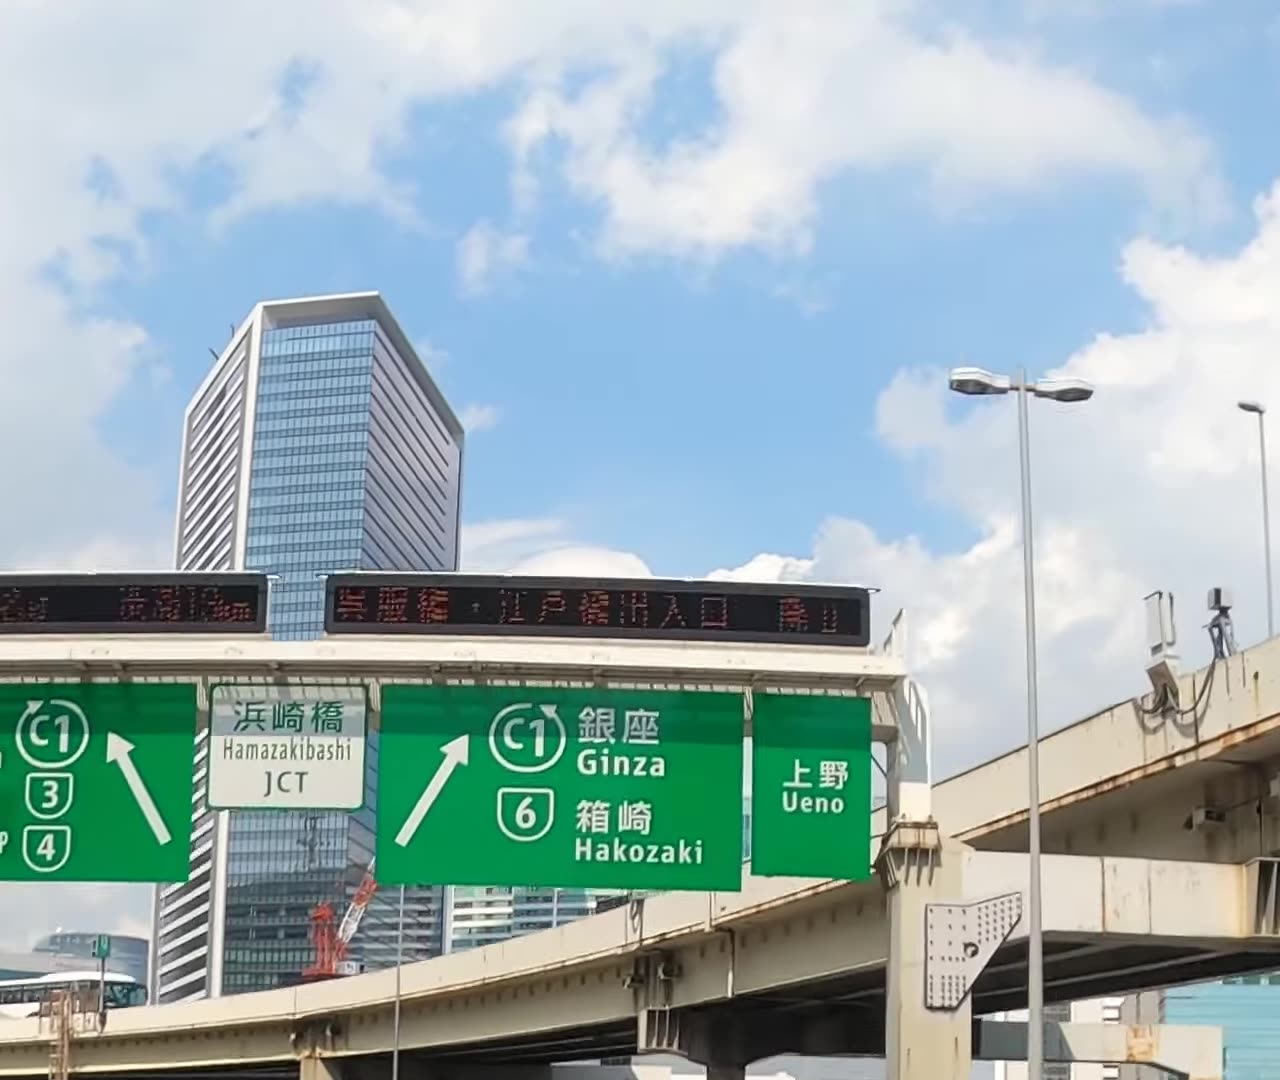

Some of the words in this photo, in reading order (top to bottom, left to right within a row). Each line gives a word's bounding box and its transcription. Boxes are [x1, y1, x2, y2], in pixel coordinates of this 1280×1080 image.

[234, 701, 343, 733] 浜崎橋
[579, 707, 659, 744] 銀座
[30, 716, 68, 752] C1
[224, 736, 350, 760] Hamazakibashi
[503, 718, 545, 758] C1
[578, 749, 664, 776] Ginza
[784, 760, 848, 789] 上野
[42, 780, 58, 808] 3
[264, 771, 309, 797] JCT
[516, 797, 536, 828] 6
[783, 792, 843, 813] Ueno
[577, 800, 651, 834] 箱崎
[37, 834, 55, 860] 4
[576, 838, 701, 863] Hakozaki
